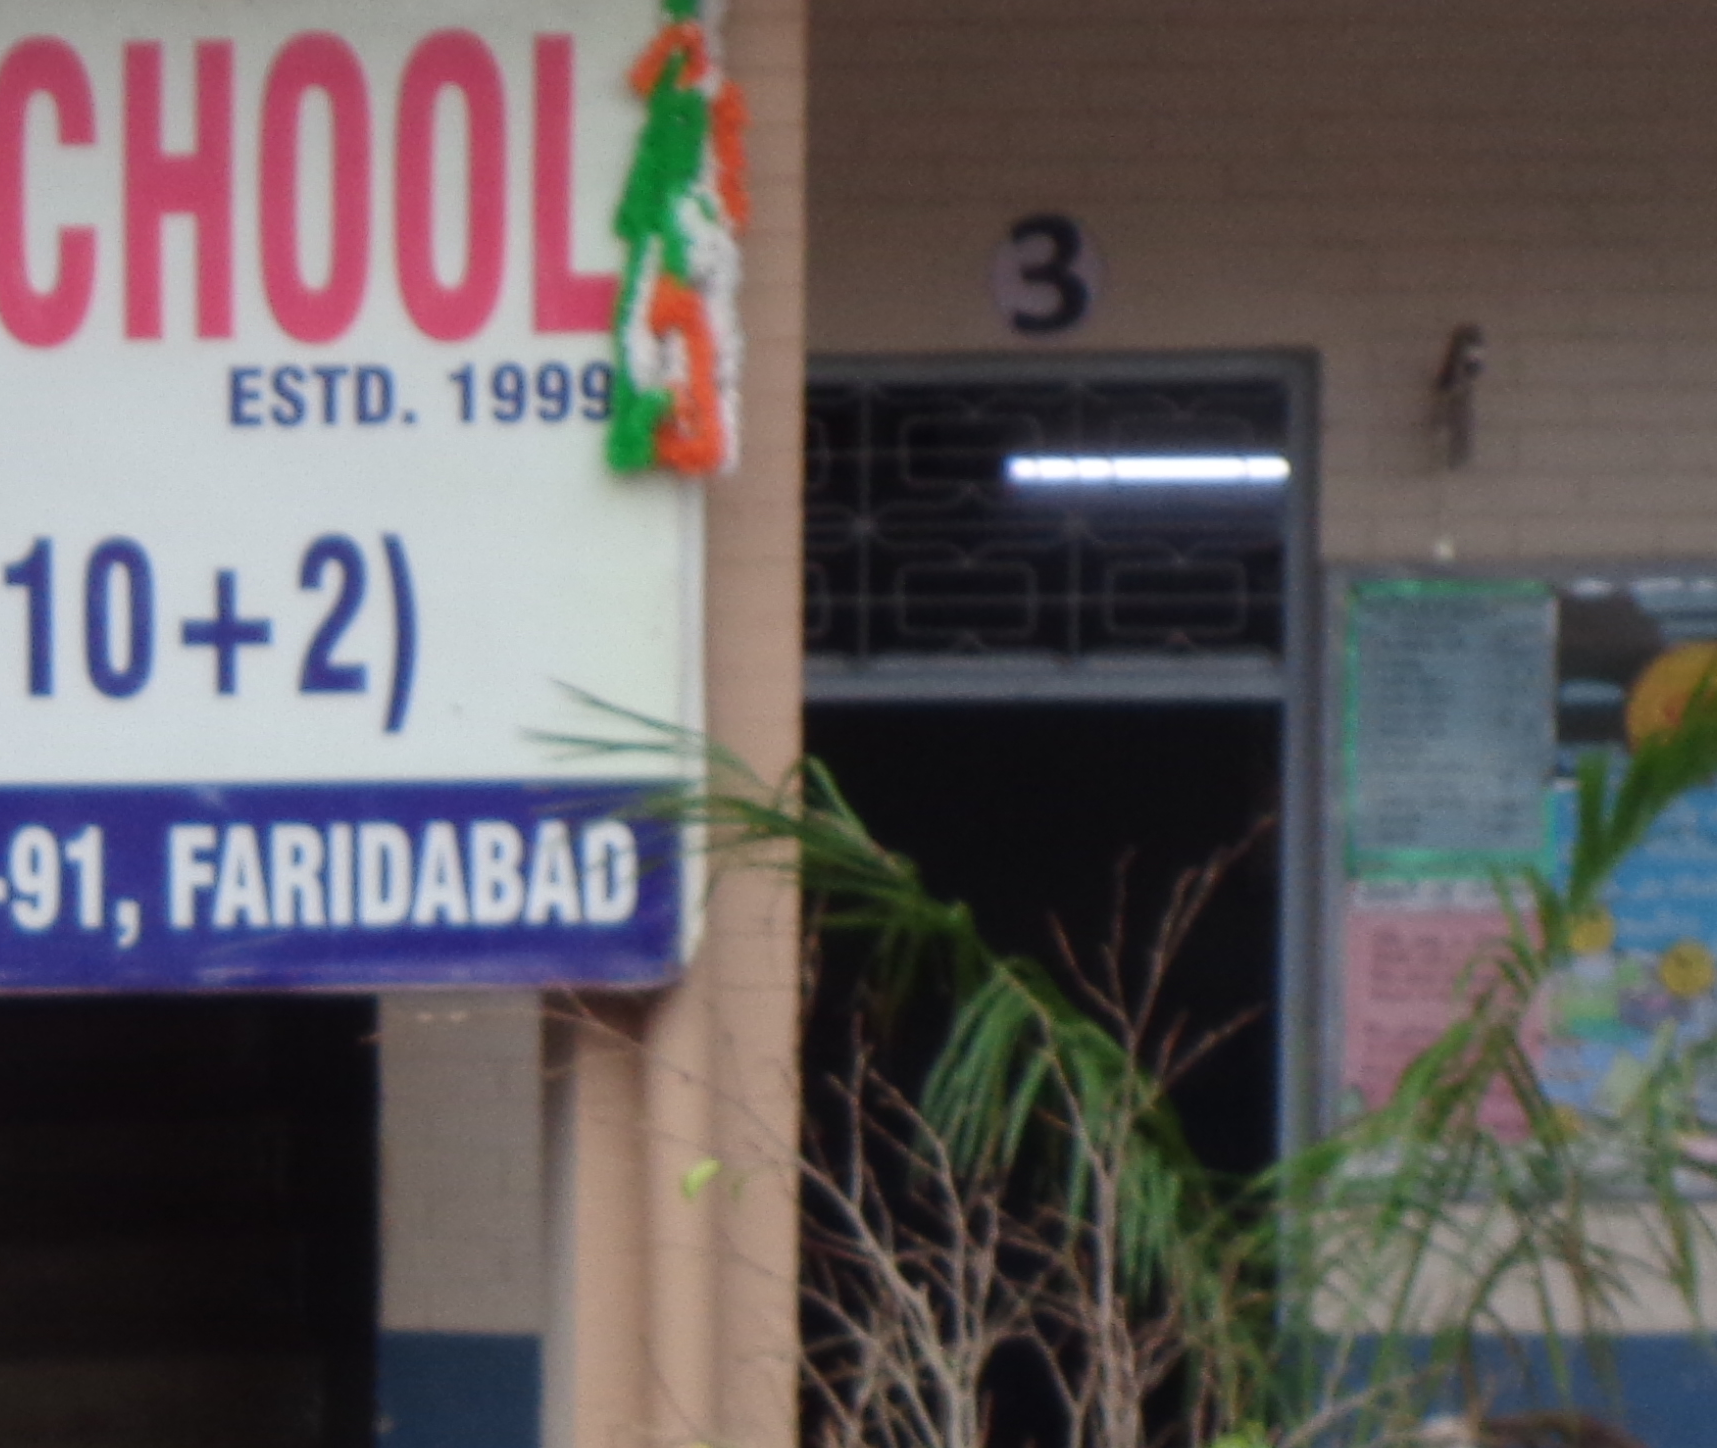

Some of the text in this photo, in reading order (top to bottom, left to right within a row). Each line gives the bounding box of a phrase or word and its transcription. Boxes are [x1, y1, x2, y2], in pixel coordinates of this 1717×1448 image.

[1011, 213, 1090, 334] 3
[227, 360, 618, 427] ESTD. 1999
[170, 820, 639, 931] FARIDABAD
